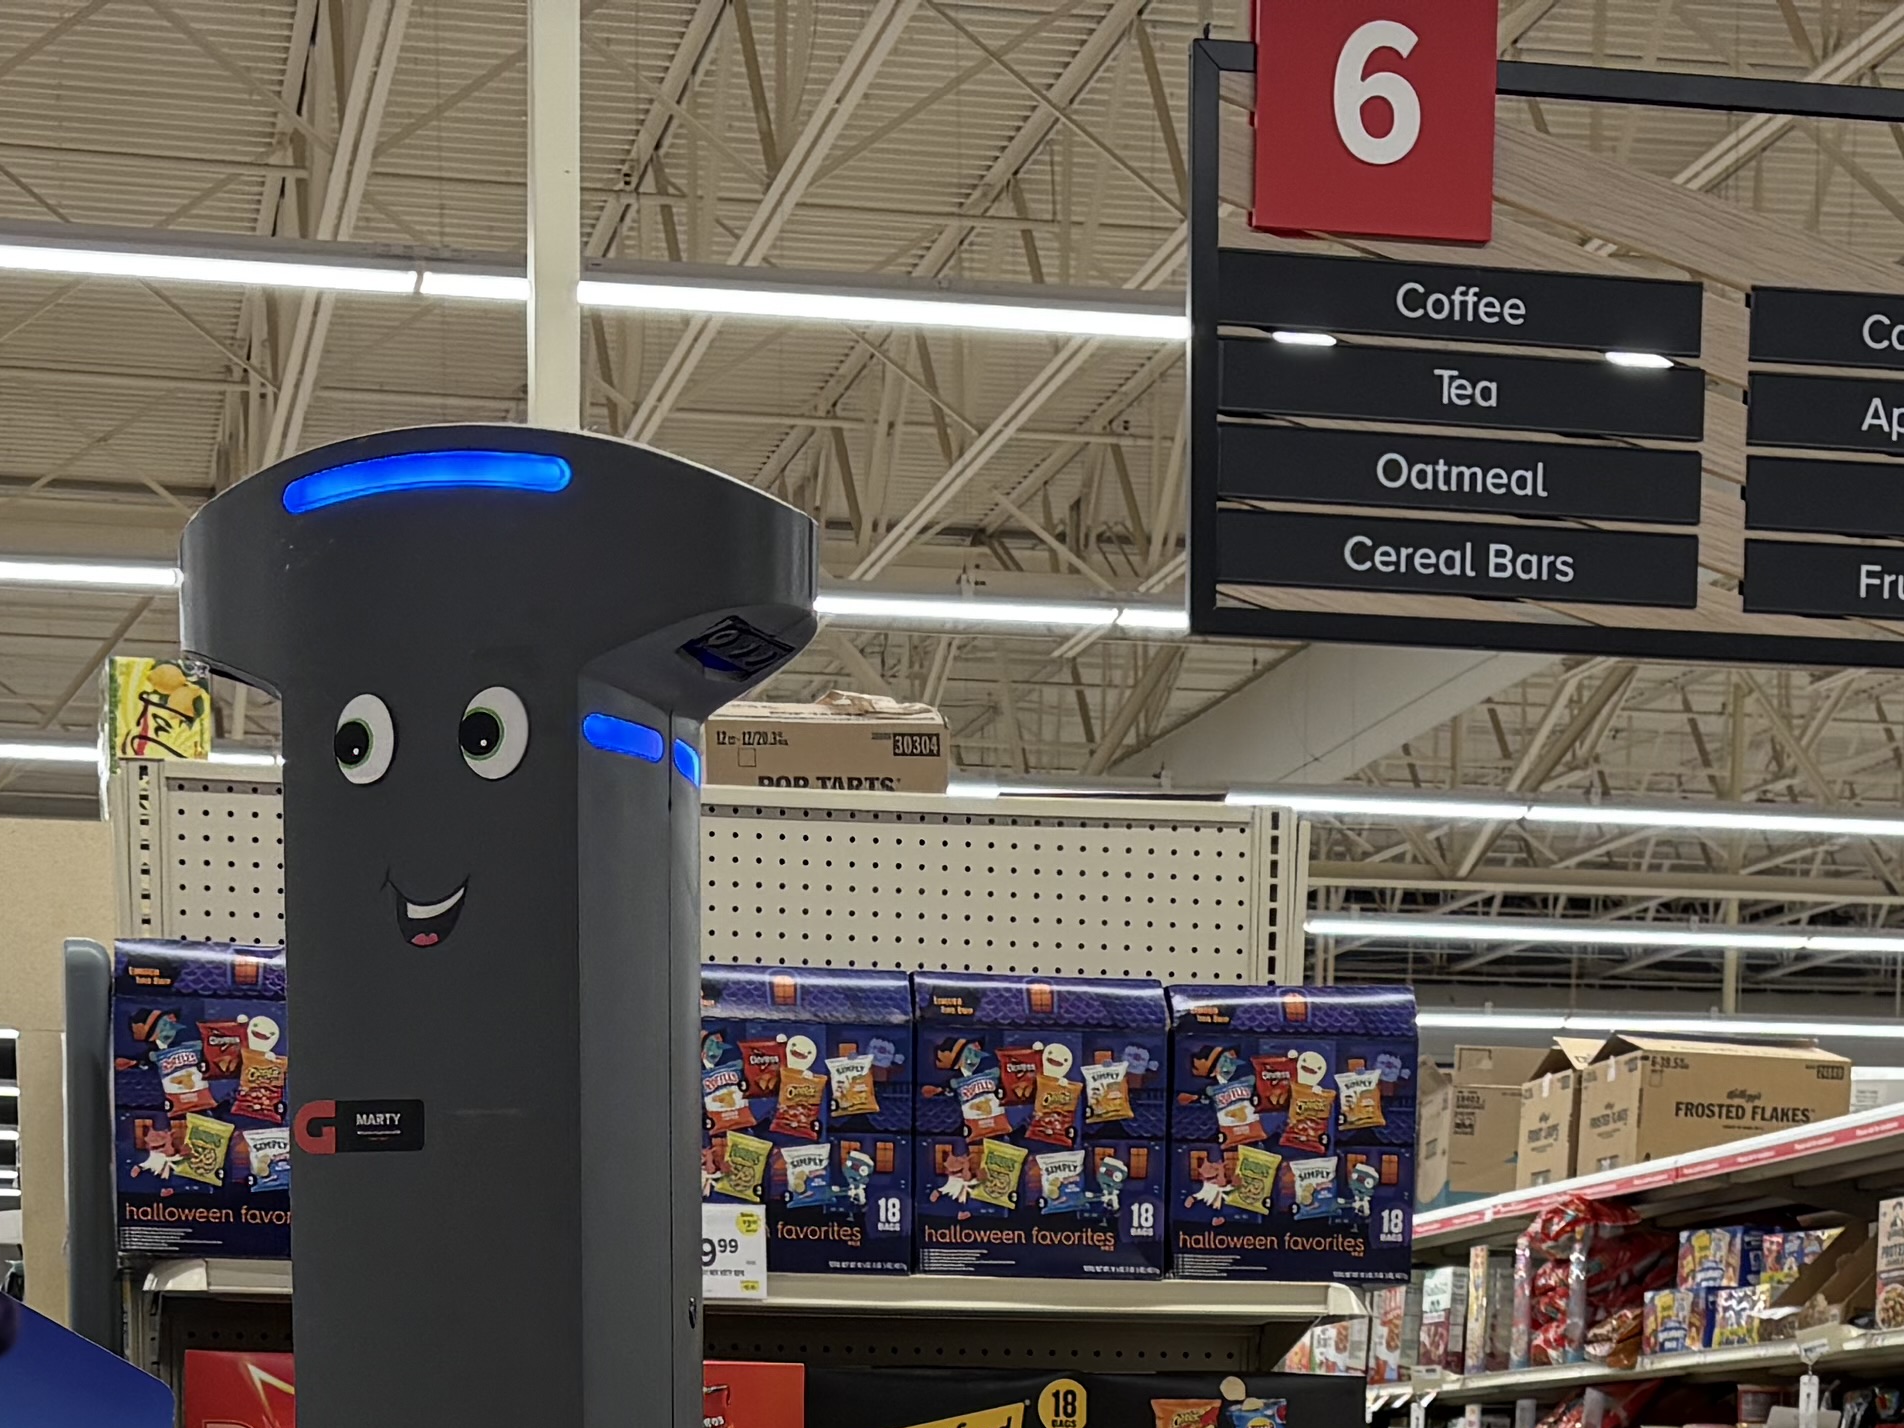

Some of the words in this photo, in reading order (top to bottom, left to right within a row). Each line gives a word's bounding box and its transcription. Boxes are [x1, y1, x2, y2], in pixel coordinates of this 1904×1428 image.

[1333, 20, 1421, 165] 6
[1396, 282, 1527, 325] Coffee
[1434, 369, 1498, 409] Tea
[1377, 454, 1548, 497] Oatmeal
[1344, 535, 1477, 578] Cereal
[1490, 544, 1575, 584] Bars
[895, 734, 939, 755] 30304
[356, 1113, 401, 1126] MARTY
[1675, 1101, 1746, 1122] FROSTED
[1751, 1104, 1810, 1124] FLAKES
[126, 1202, 234, 1223] halloween
[777, 1221, 861, 1241] favorites
[925, 1225, 1025, 1244] halloween
[1284, 1234, 1364, 1253] favorites
[1047, 1386, 1078, 1419] 18
